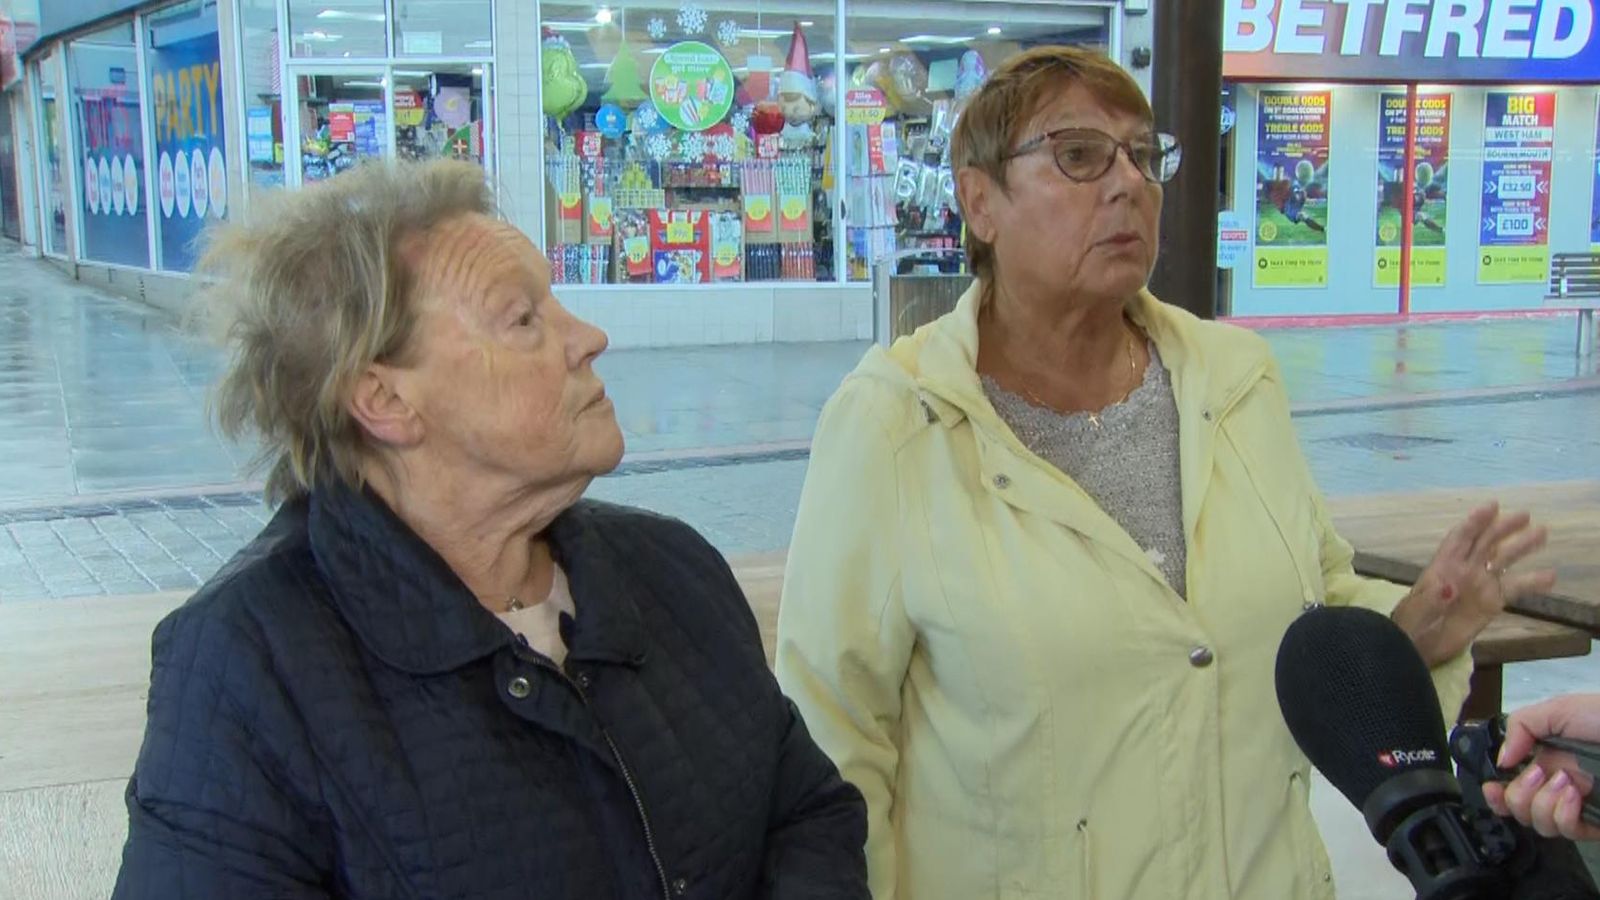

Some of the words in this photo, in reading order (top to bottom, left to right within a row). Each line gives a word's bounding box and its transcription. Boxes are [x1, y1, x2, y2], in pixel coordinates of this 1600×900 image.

[1223, 0, 1592, 59] BETFRED
[153, 62, 219, 143] PARTY
[1264, 96, 1299, 105] DOUBLE
[1301, 96, 1326, 106] ODDS
[1422, 99, 1446, 109] ODDS
[1507, 96, 1535, 114] BIG
[1502, 114, 1538, 126] MATCH
[1265, 123, 1298, 133] TREBLE
[1300, 123, 1324, 133] ODDS
[1420, 126, 1444, 135] ODDS
[1495, 130, 1520, 139] WEST
[1522, 130, 1543, 139] HAM
[1486, 149, 1548, 158] BOURNEMOUTH
[1503, 219, 1529, 230] £100
[1392, 749, 1436, 765] Rycote
